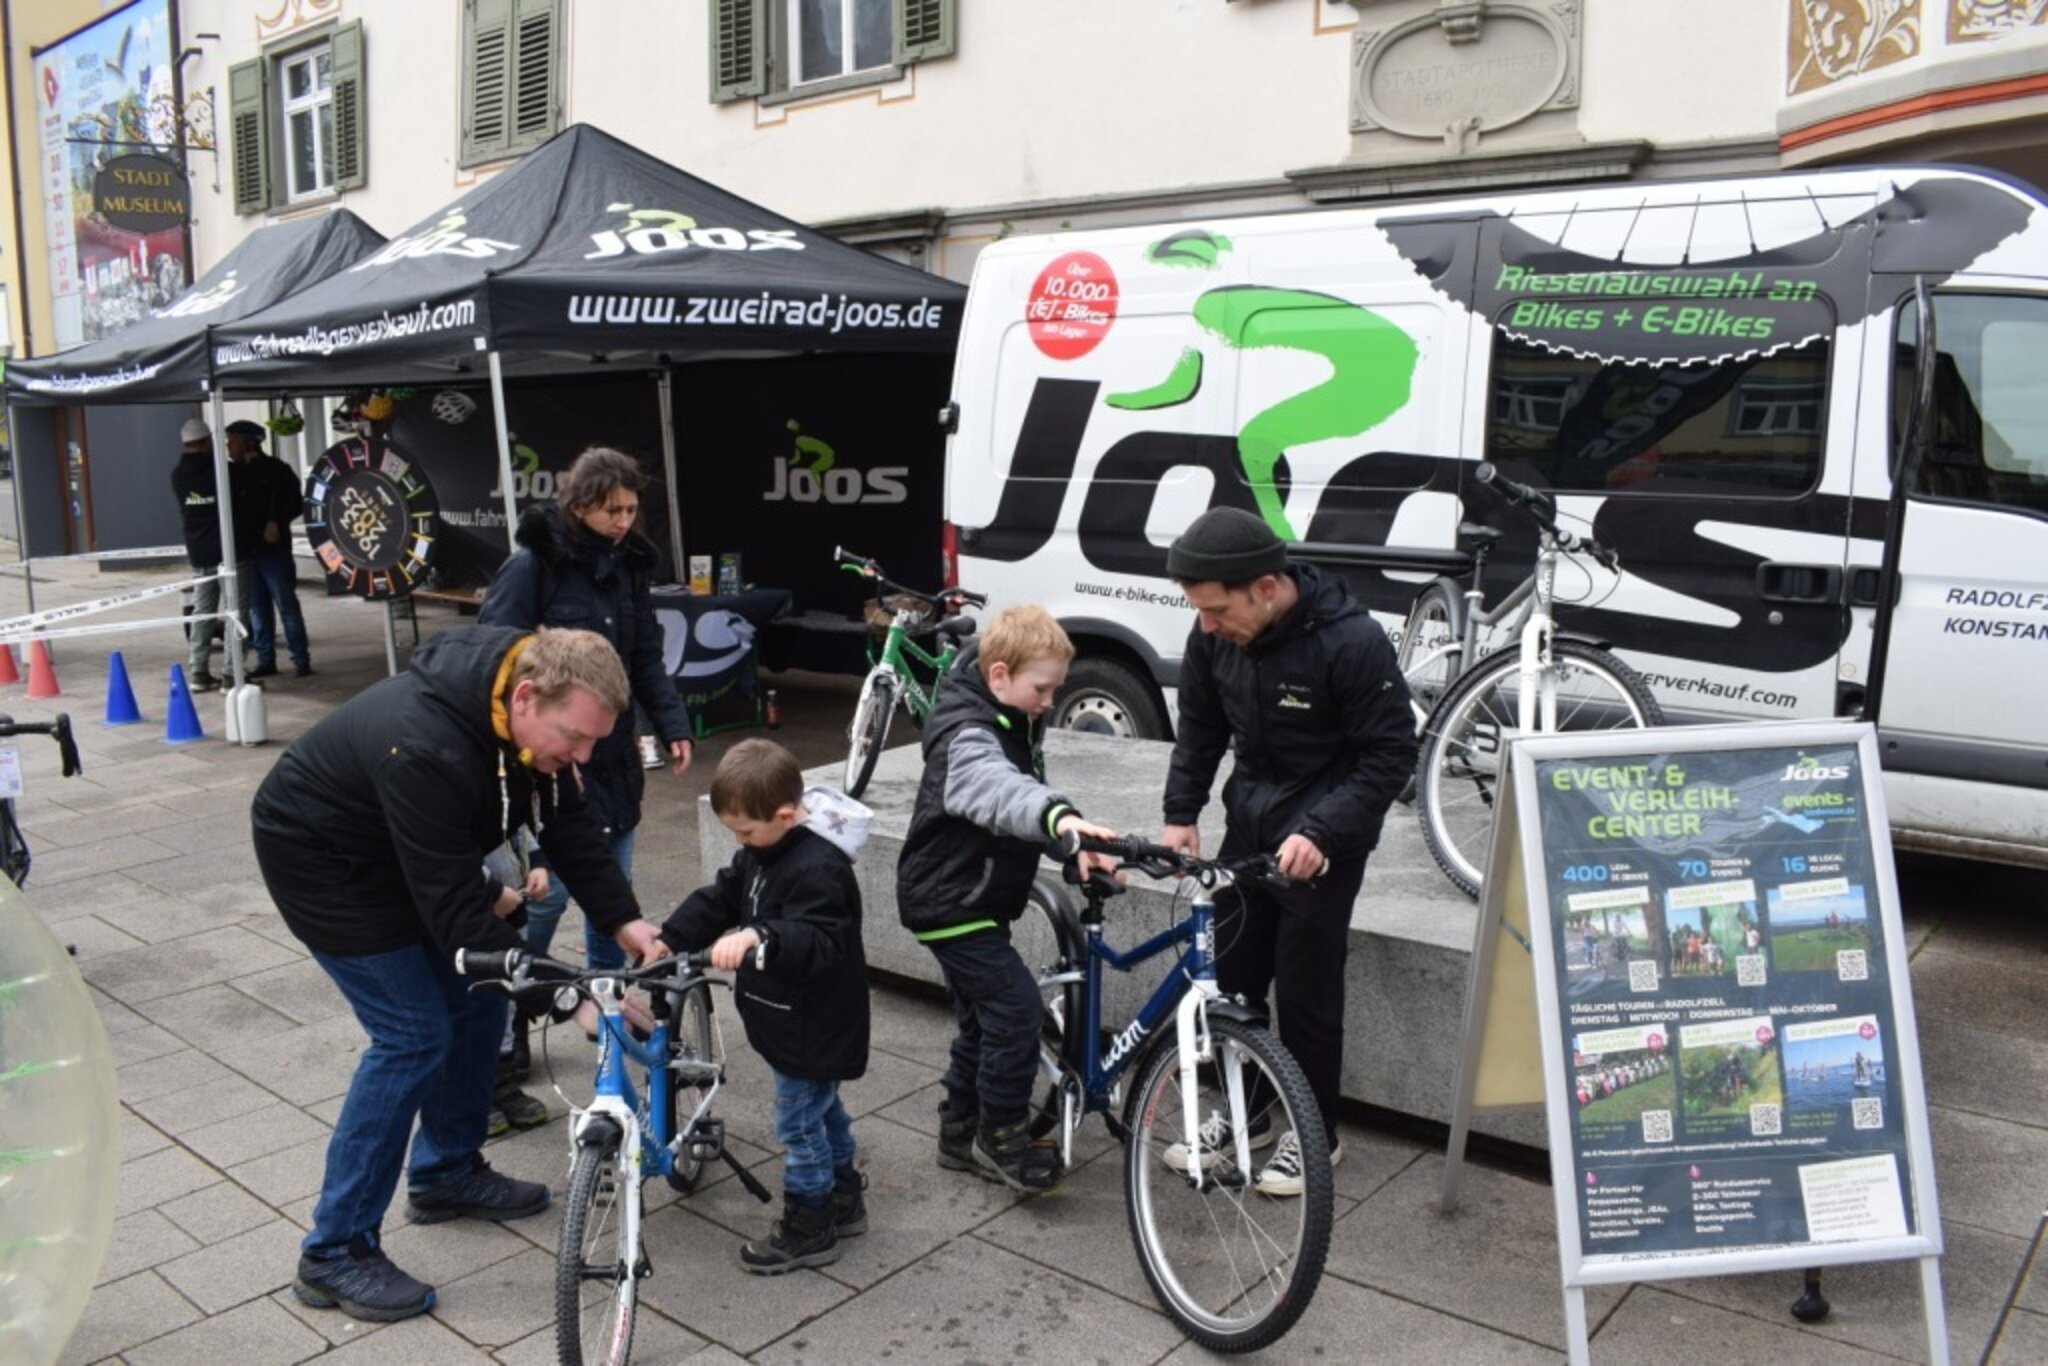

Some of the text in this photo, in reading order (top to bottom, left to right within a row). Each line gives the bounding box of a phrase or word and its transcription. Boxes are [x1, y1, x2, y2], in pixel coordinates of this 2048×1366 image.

[113, 169, 172, 187] STADT
[103, 196, 184, 215] MUSEUM
[1044, 277, 1109, 300] 10.000
[1495, 266, 1817, 302] Riesenauswahl an
[568, 292, 942, 334] www.zweirad-joos.de
[1511, 301, 1776, 339] Bikes + E-Bikes
[1553, 764, 1685, 790] EVENT- &
[1610, 787, 1740, 813] VERLEIH-
[1588, 814, 1701, 838] CENTER
[1562, 865, 1607, 881] 400
[1678, 860, 1708, 878] 70
[1782, 856, 1806, 873] 16
[1618, 1001, 1655, 1010] TOUREN
[1571, 1014, 1619, 1024] DIENSTAG
[1629, 1011, 1679, 1022] MITTWOCH
